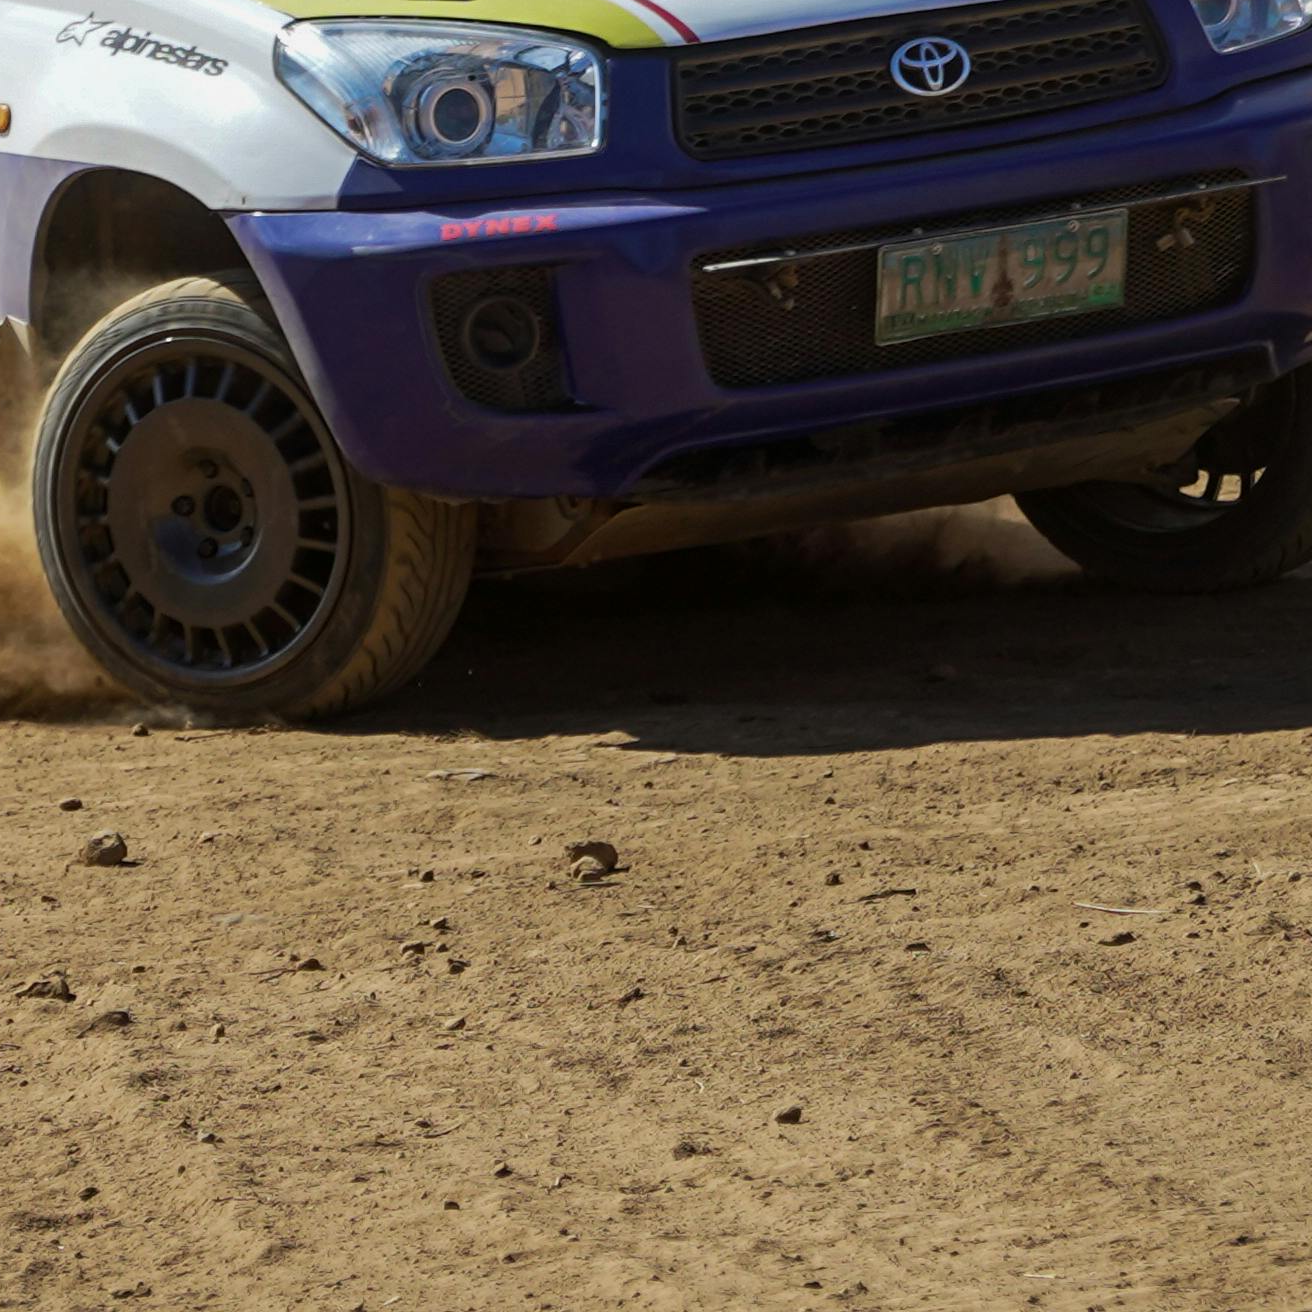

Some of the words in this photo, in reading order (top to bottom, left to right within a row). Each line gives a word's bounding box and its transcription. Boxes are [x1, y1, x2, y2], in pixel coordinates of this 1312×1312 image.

[100, 27, 229, 76] alpinestars
[440, 213, 560, 241] DYNEX
[1022, 224, 1111, 289] 999
